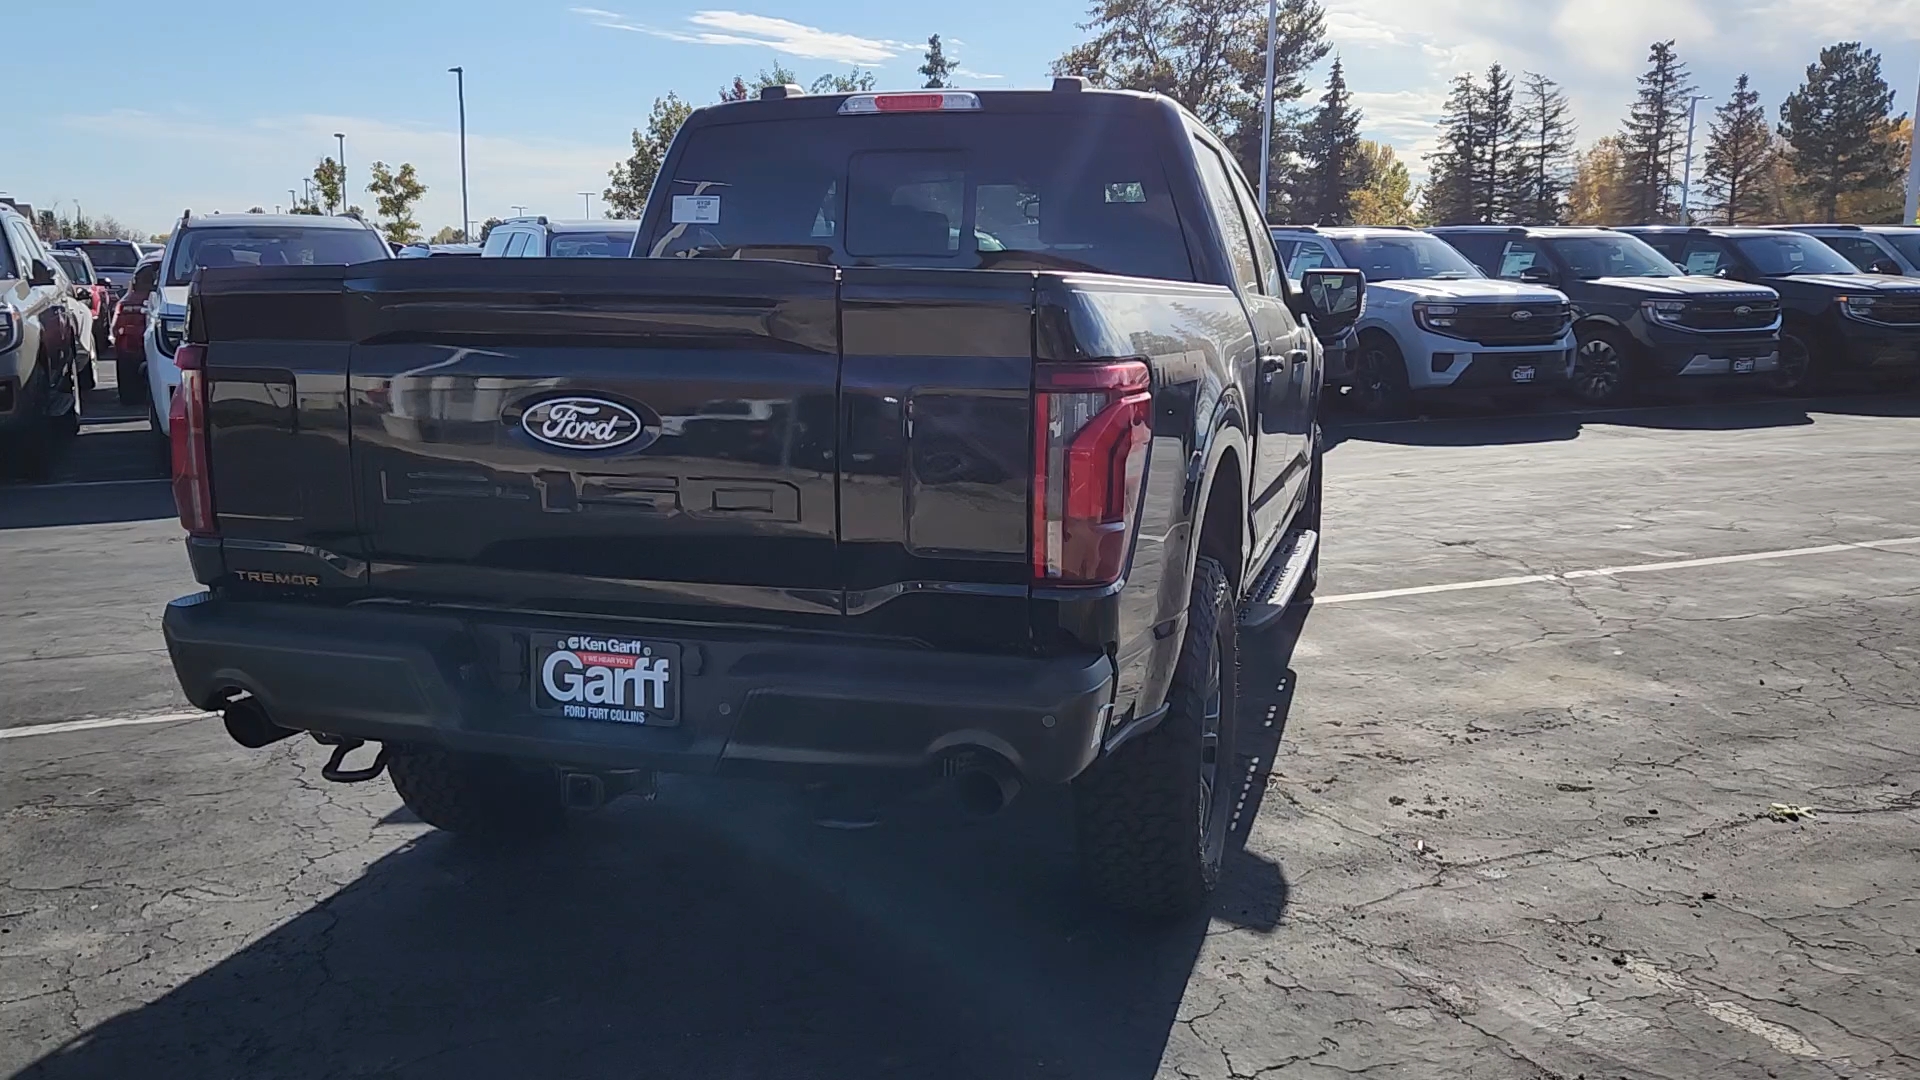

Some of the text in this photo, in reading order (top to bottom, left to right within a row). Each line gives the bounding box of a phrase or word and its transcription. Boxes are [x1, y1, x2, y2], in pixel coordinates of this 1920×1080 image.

[1512, 369, 1535, 380] Garff
[542, 404, 619, 441] Ford
[234, 570, 319, 586] TREMOR
[579, 636, 641, 653] Ken Garff
[587, 655, 598, 663] WE
[599, 656, 616, 664] HEAR
[542, 650, 669, 709] Garff
[564, 705, 645, 724] FORD FORT COLLINS
